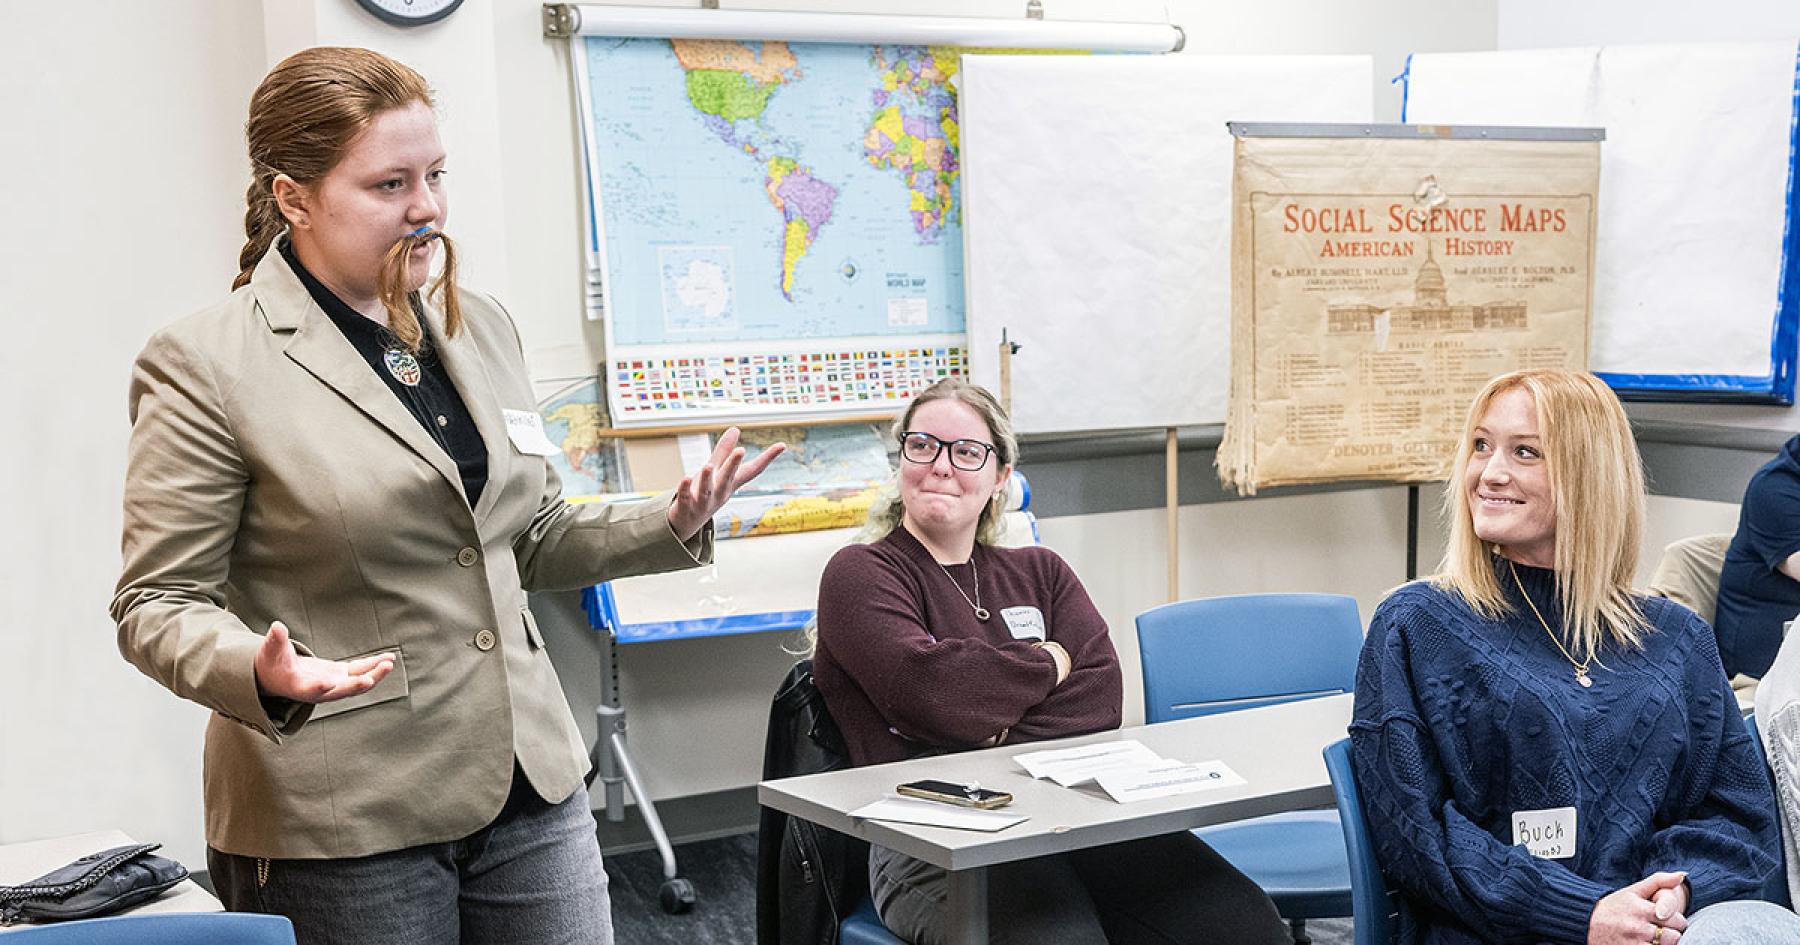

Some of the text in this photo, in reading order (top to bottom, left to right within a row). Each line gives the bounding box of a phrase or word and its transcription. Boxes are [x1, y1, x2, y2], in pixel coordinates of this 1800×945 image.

[1283, 203, 1374, 233] SOCIAL
[1500, 203, 1567, 233] MAPS
[1320, 237, 1515, 257] AMERICAN HISTORY
[1519, 820, 1564, 844] Buck
